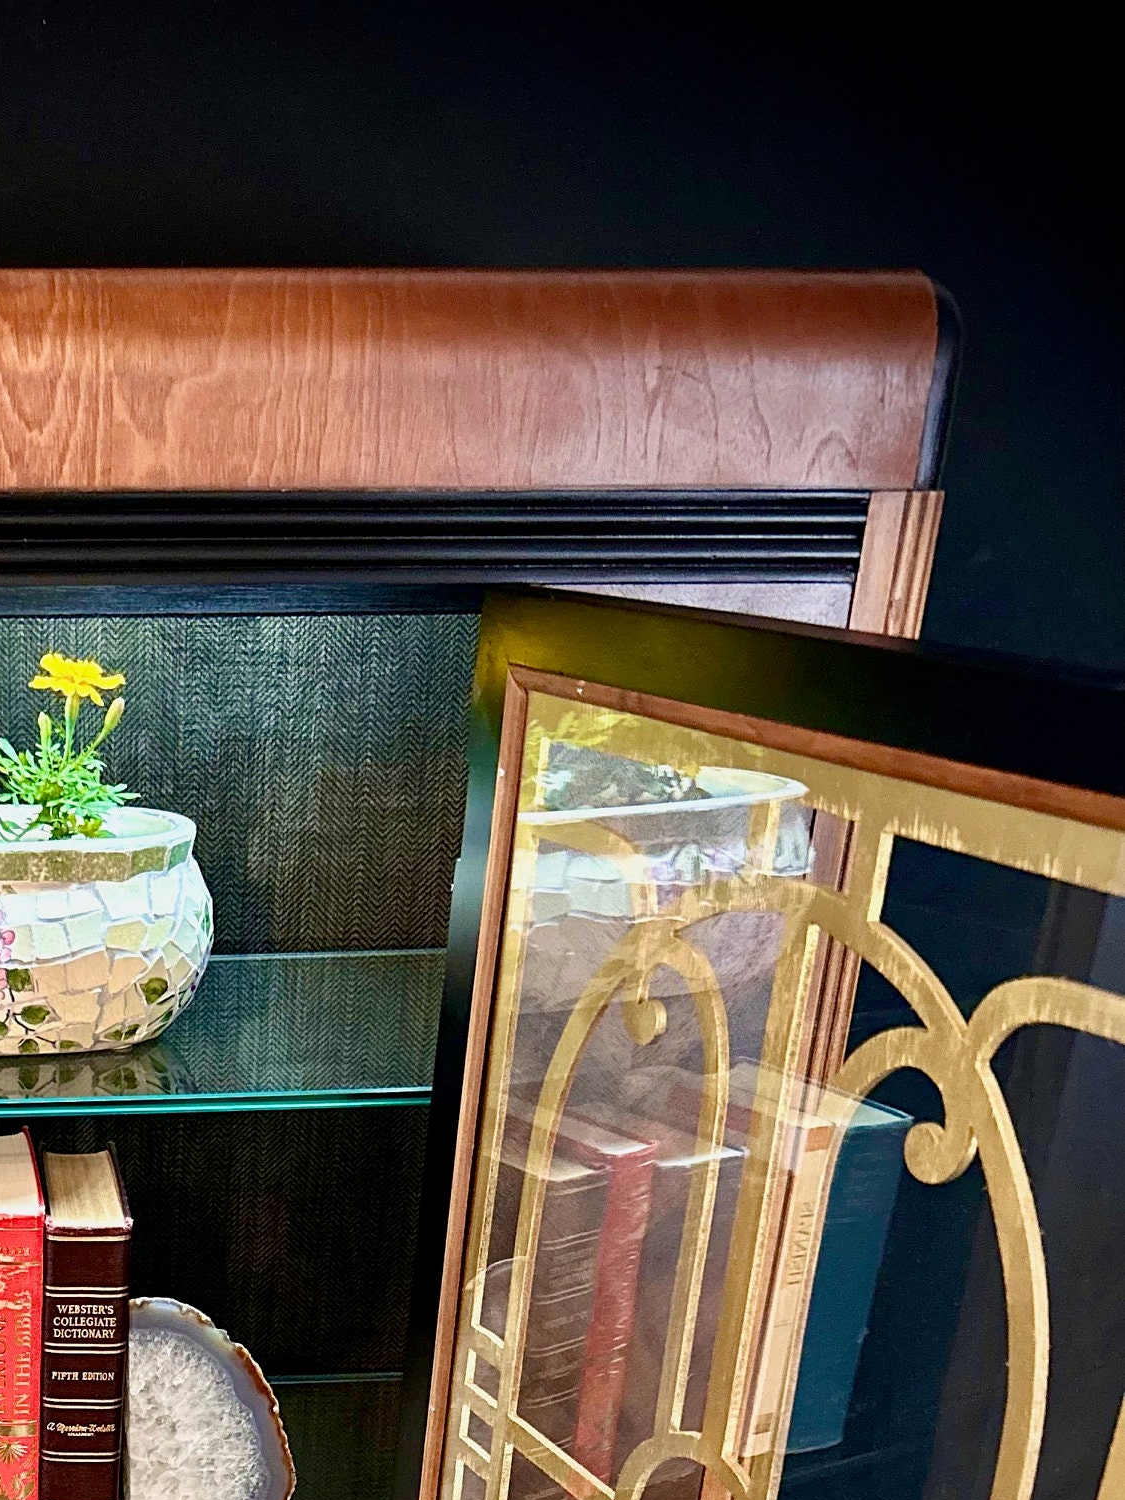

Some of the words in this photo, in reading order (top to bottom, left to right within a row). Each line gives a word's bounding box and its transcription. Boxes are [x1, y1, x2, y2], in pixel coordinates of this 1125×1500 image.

[56, 1304, 114, 1315] WEBSTER'S
[53, 1316, 117, 1327] COLLEGIATE
[53, 1328, 116, 1339] DICTIONARY
[13, 1351, 31, 1389] THE
[51, 1372, 79, 1380] FIFTH
[82, 1372, 115, 1381] EDITION
[13, 1391, 30, 1416] IN
